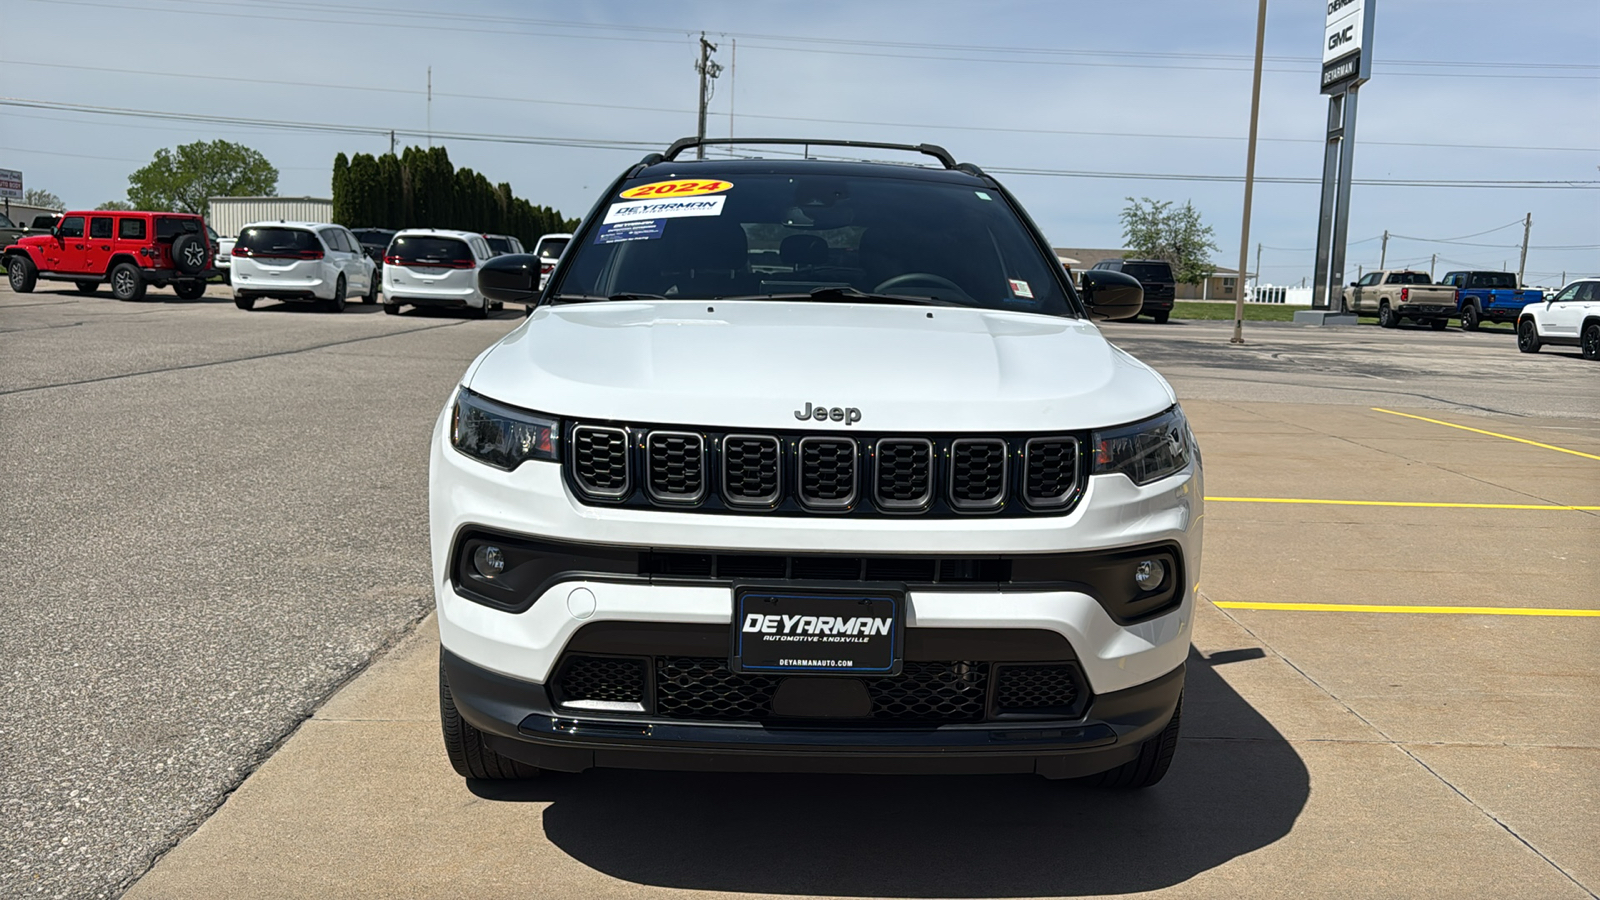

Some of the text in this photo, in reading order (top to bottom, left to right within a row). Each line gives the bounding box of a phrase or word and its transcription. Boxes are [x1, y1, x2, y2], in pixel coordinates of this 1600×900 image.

[1328, 25, 1353, 50] GMC
[1324, 61, 1353, 84] DEYARMAN
[630, 181, 722, 197] 2024
[615, 201, 718, 214] DEYARMAN
[794, 402, 862, 426] Jeep
[742, 613, 893, 636] DEYARMAN
[779, 658, 853, 667] DEYARMANAUTO.COM
